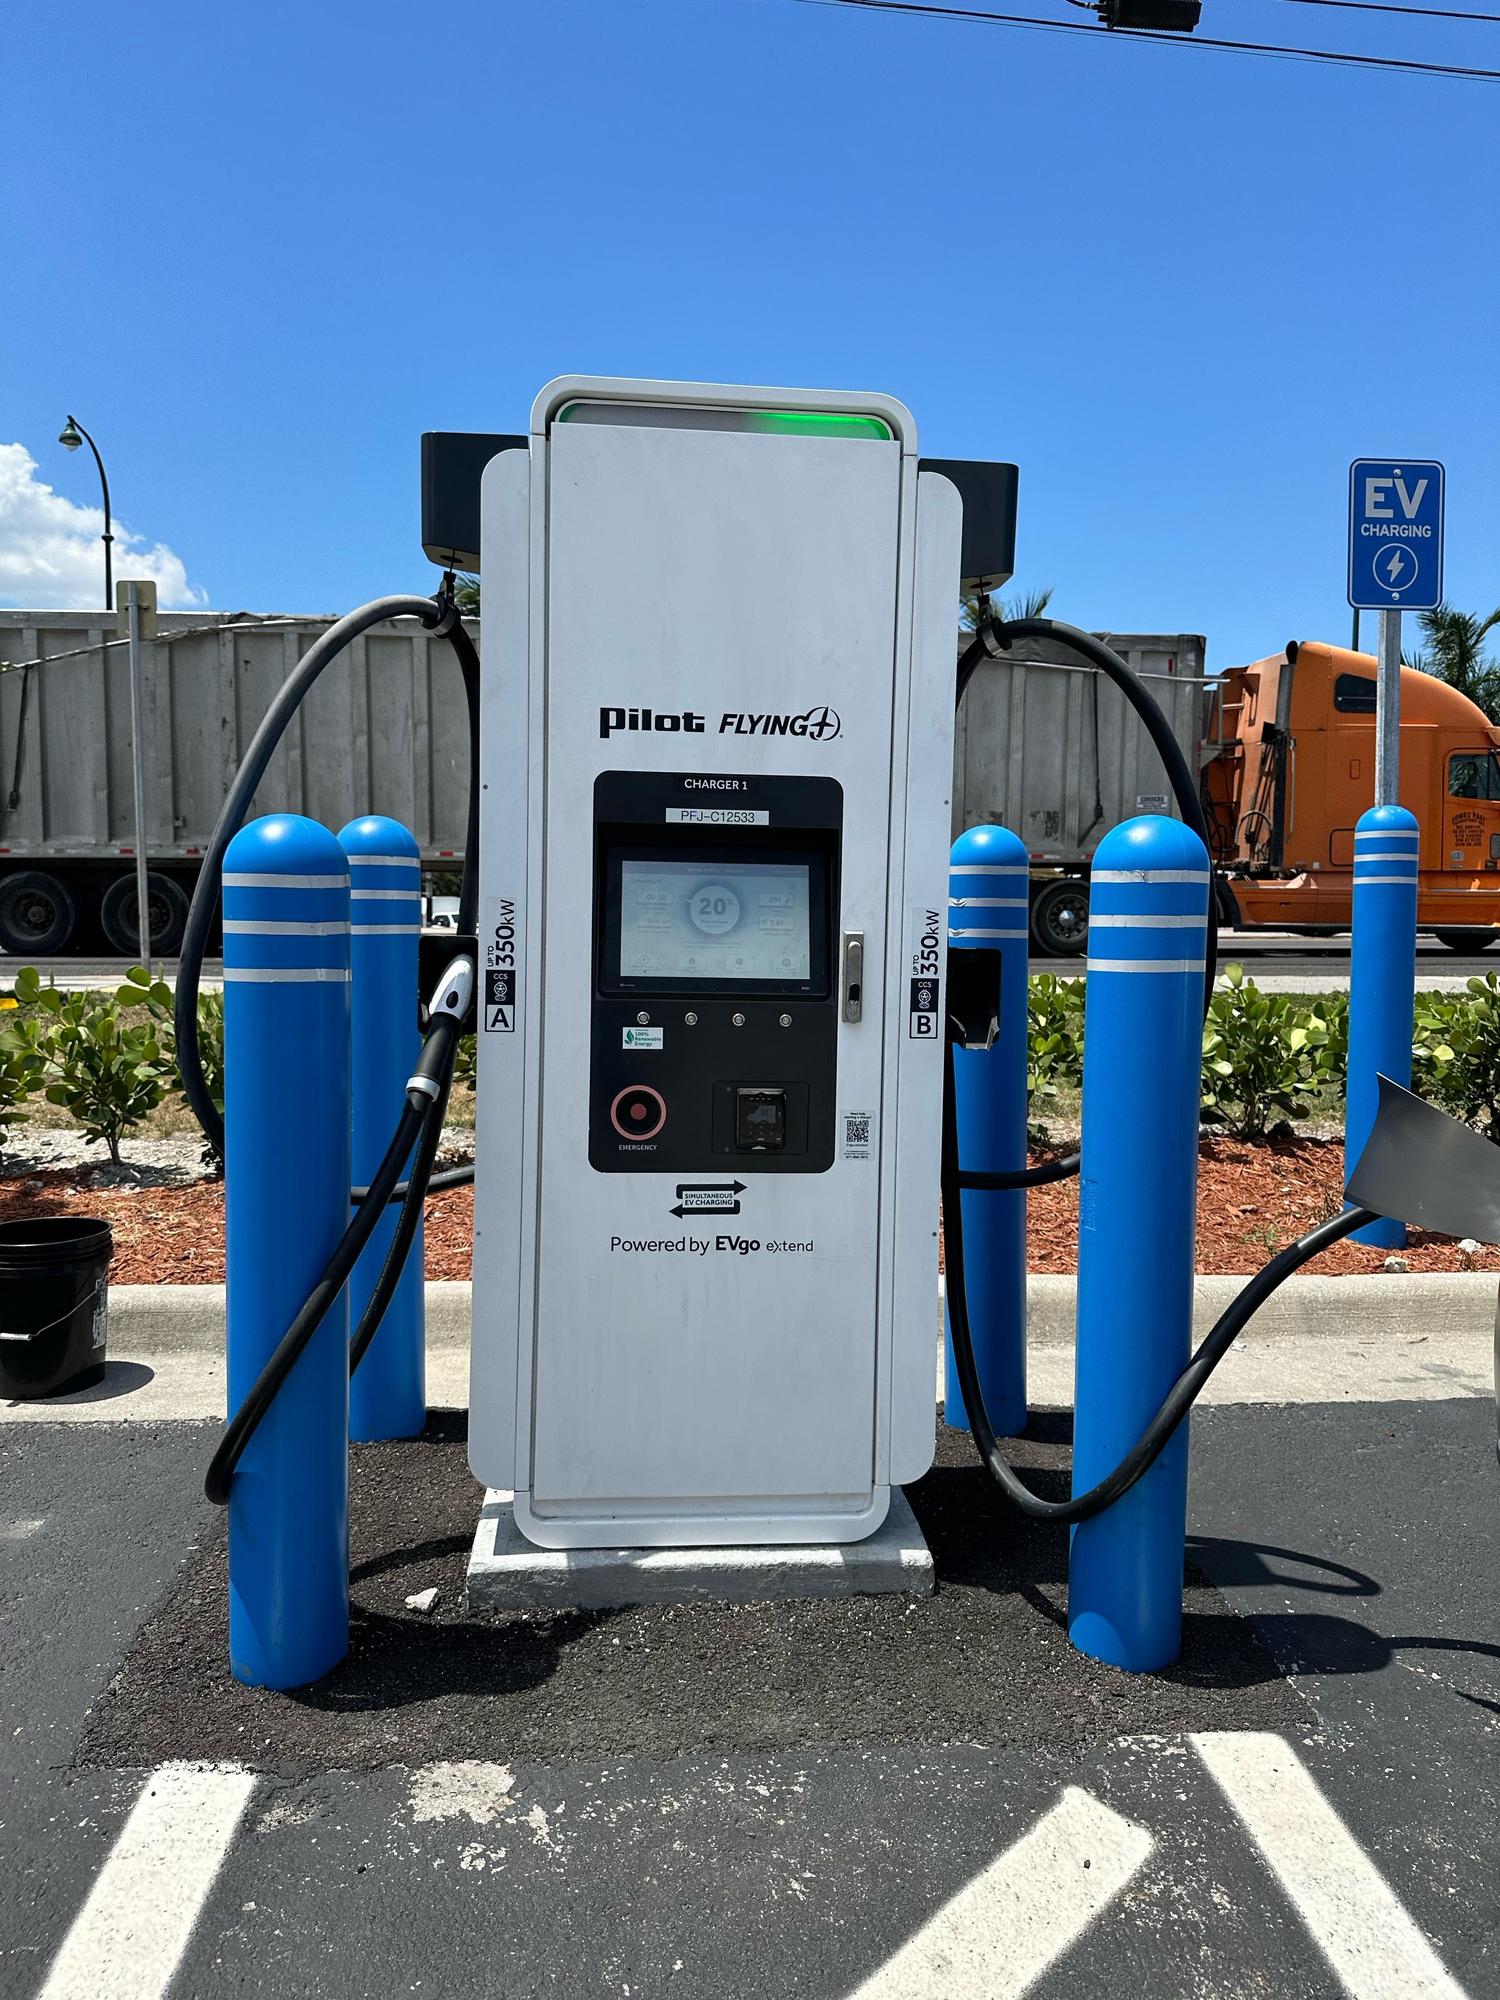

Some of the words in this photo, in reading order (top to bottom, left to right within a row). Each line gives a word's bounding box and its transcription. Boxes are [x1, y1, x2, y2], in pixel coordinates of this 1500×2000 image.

[1365, 477, 1429, 519] EV
[1360, 523, 1432, 538] CHARGING
[600, 707, 705, 738] pilot
[684, 778, 739, 790] CHARGER
[742, 781, 748, 790] 1
[681, 810, 755, 823] PFJ-C12533
[495, 899, 515, 967] 350kW
[487, 945, 494, 956] TO
[920, 909, 939, 976] 350kW
[487, 957, 494, 967] UP
[912, 954, 919, 965] TO
[912, 966, 919, 976] UP
[490, 1007, 509, 1028] A
[917, 1015, 931, 1035] B
[610, 1236, 686, 1252] Powered
[689, 1237, 710, 1255] by
[715, 1235, 760, 1255] EVgo
